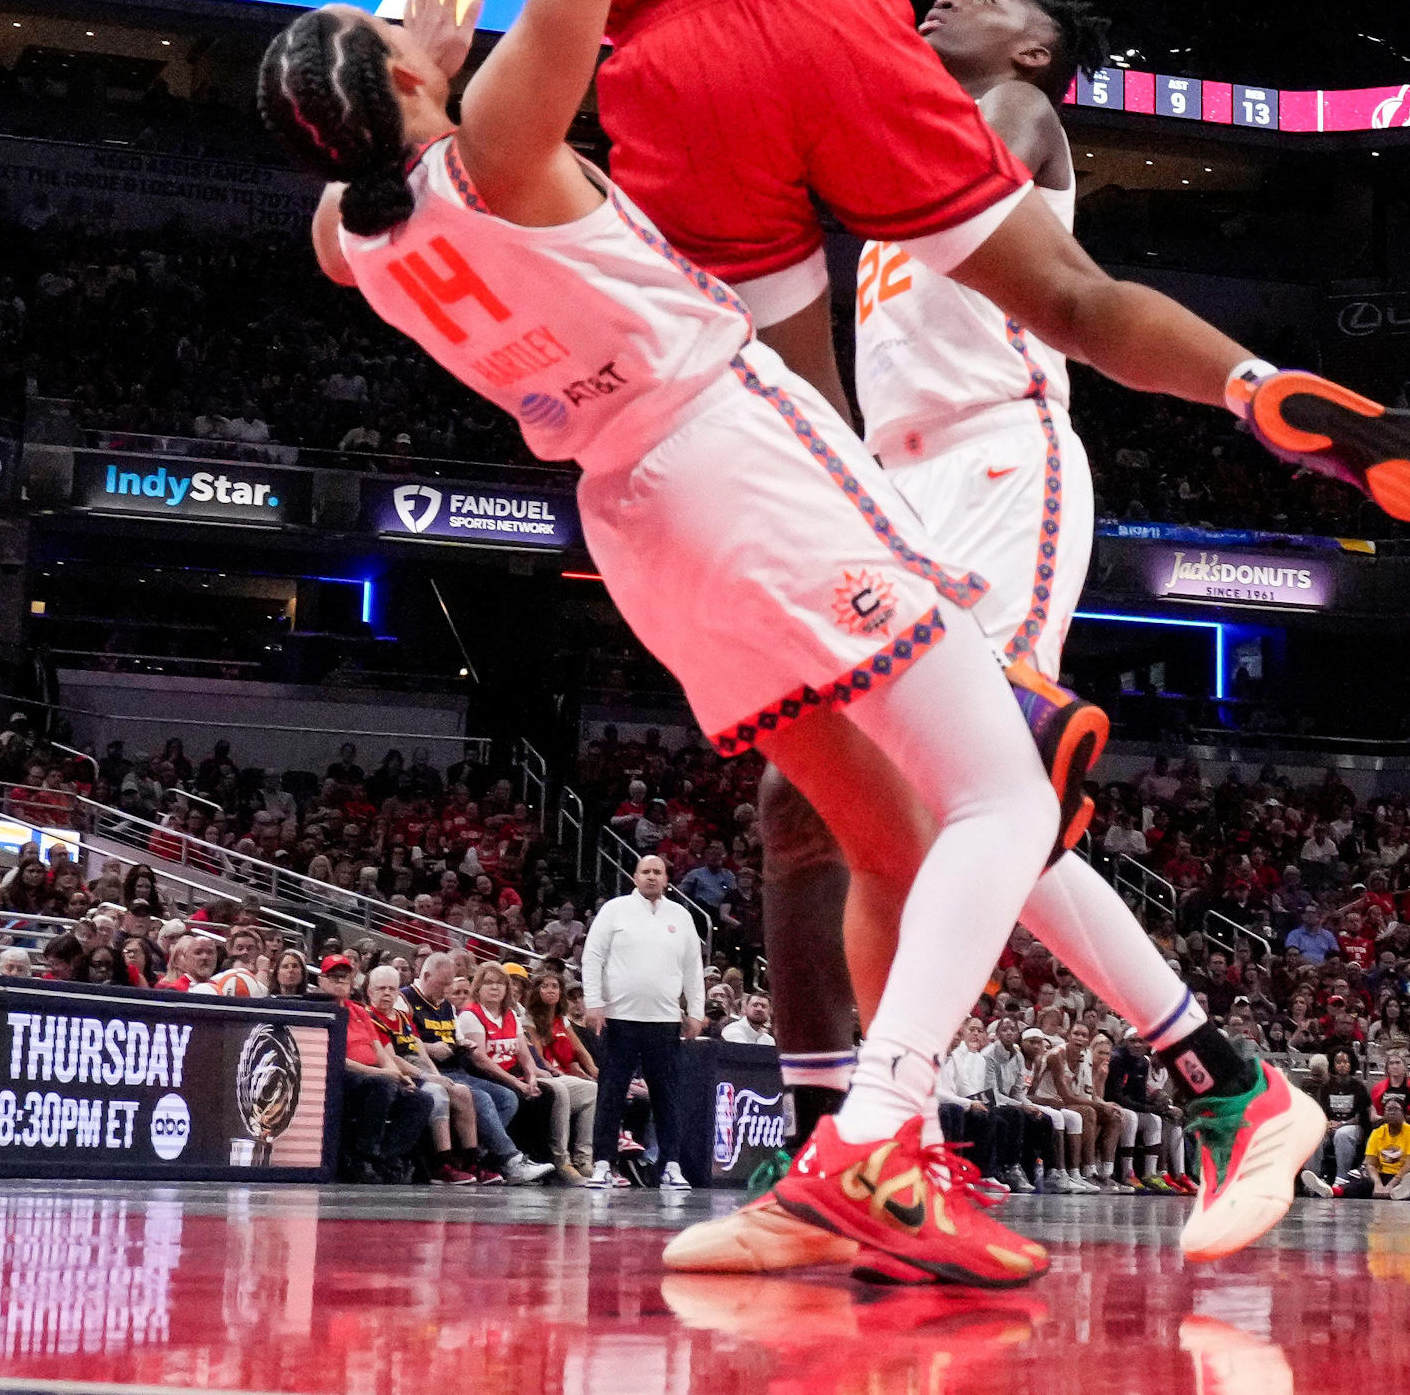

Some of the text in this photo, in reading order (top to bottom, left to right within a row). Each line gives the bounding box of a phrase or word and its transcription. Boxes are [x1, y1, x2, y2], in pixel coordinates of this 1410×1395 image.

[1093, 83, 1108, 104] 5
[1171, 93, 1186, 114] 9
[1242, 102, 1271, 125] 13
[387, 234, 514, 345] 14
[562, 360, 628, 408] AT&T
[104, 464, 280, 507] IndyStar.
[449, 494, 556, 522] FANDUEL
[449, 516, 555, 535] SPORTS NETWORK
[1220, 563, 1312, 589] DONUTS
[1206, 587, 1275, 601] SINCE 1961
[7, 1013, 192, 1087] THURSDAY
[105, 1101, 140, 1148] ET
[155, 1113, 188, 1136] abc
[722, 1088, 785, 1171] Fina
